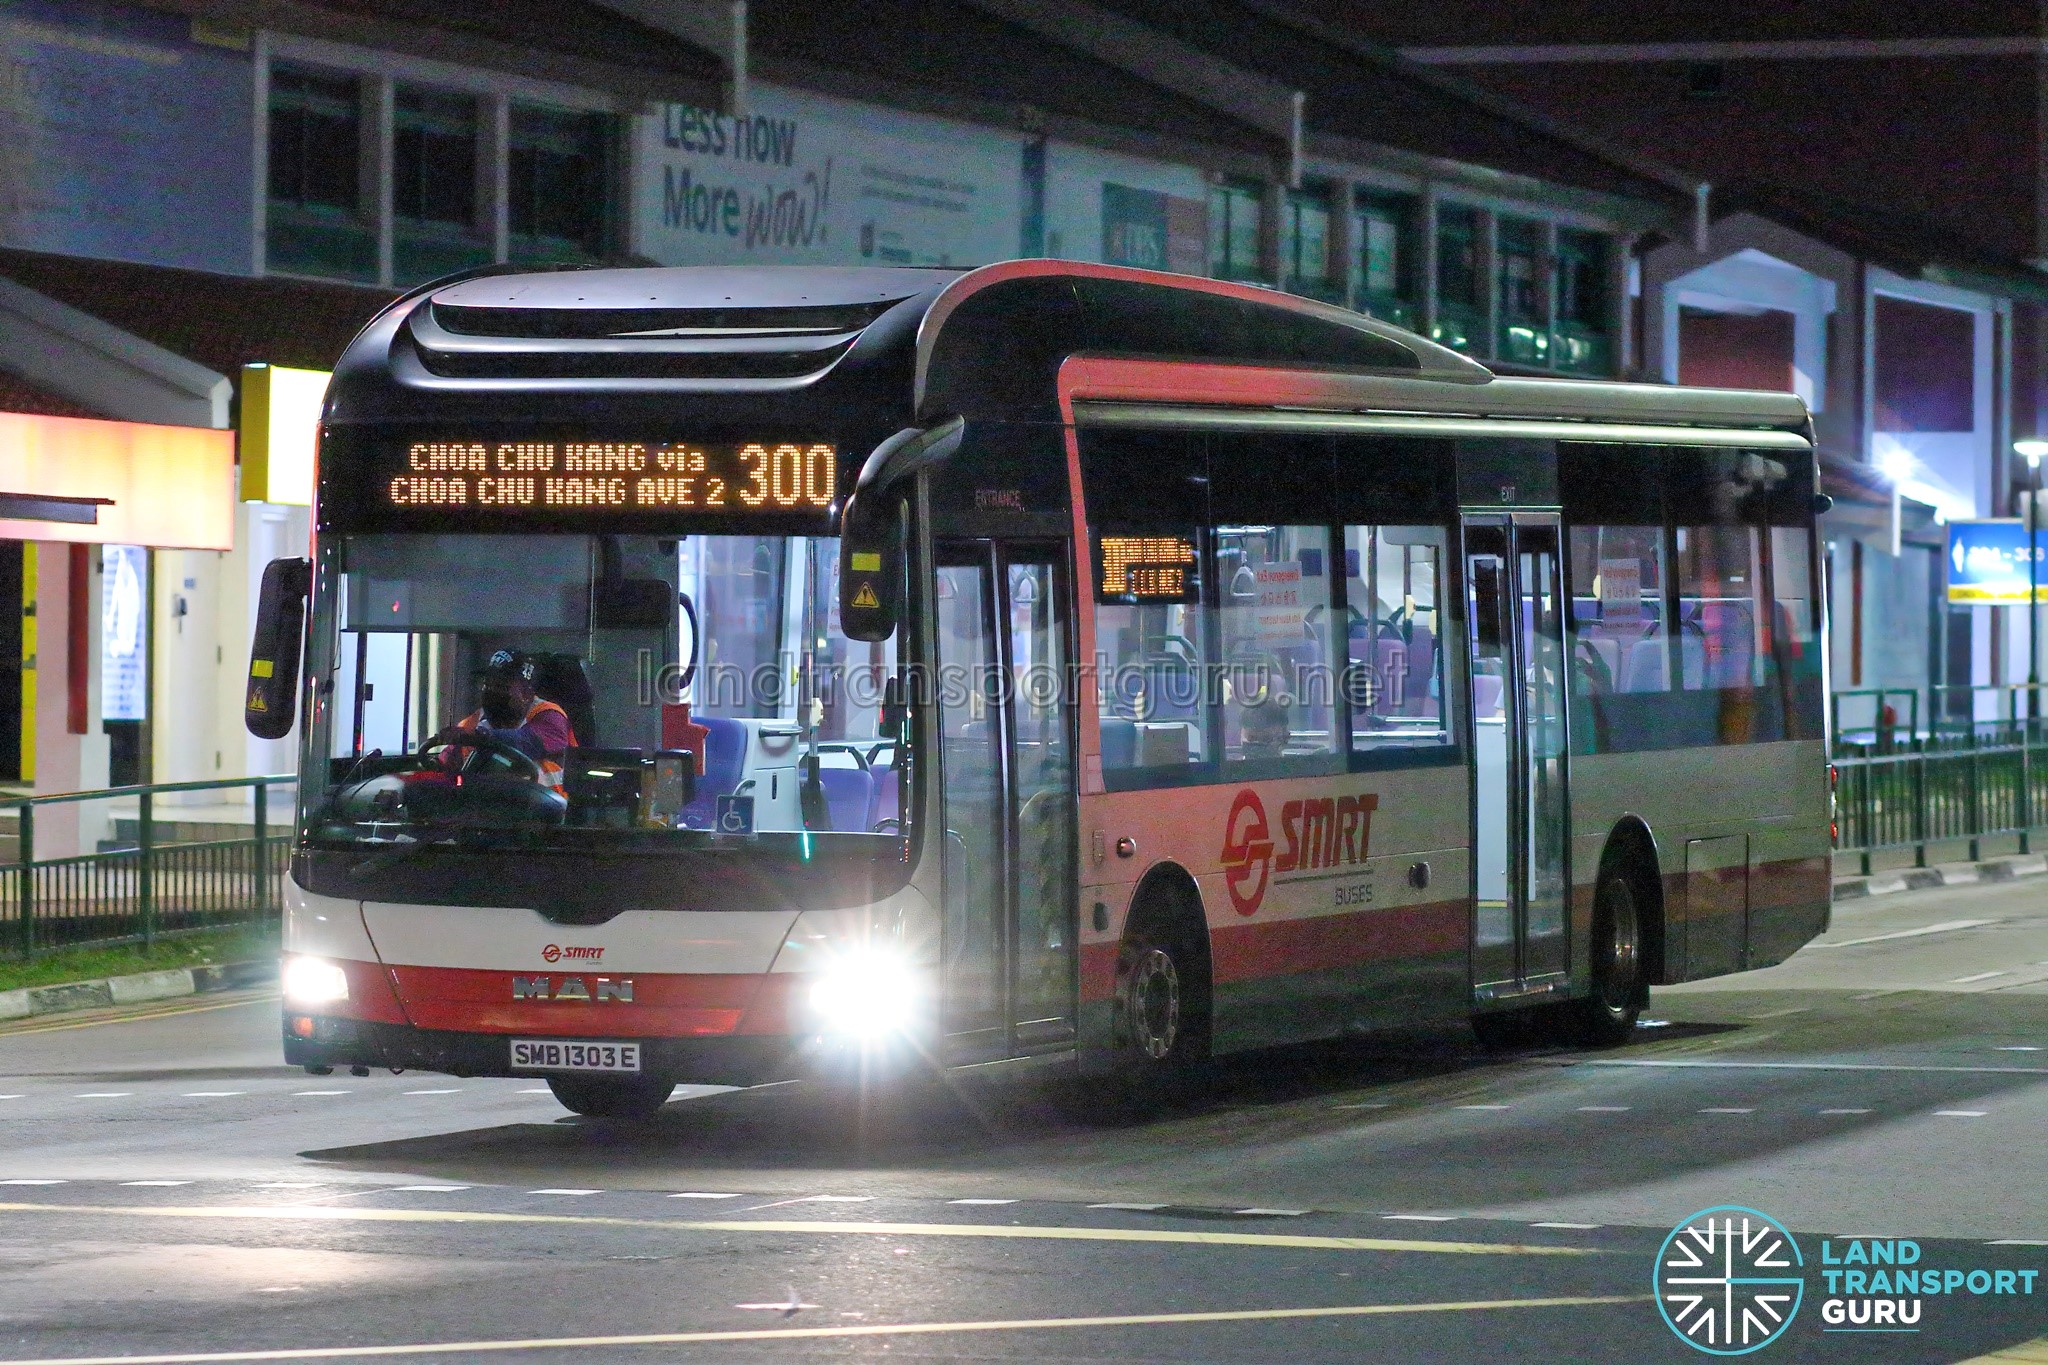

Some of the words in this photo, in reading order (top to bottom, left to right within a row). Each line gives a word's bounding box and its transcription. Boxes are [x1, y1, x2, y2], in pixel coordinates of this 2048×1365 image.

[663, 103, 727, 156] Less
[735, 115, 795, 167] now
[663, 164, 741, 236] More
[409, 444, 486, 471] CHOA
[497, 444, 554, 471] CHU
[565, 444, 646, 471] KANG
[656, 444, 705, 471] via
[739, 444, 836, 505] 300
[390, 477, 467, 504] CHOA
[477, 477, 535, 504] CHU
[545, 477, 626, 504] KANG
[637, 477, 695, 504] AVE
[706, 477, 725, 505] 2
[1275, 793, 1379, 872] SMRT
[1334, 883, 1373, 905] BUSES
[562, 946, 605, 959] SMRT
[512, 976, 634, 1002] MAN
